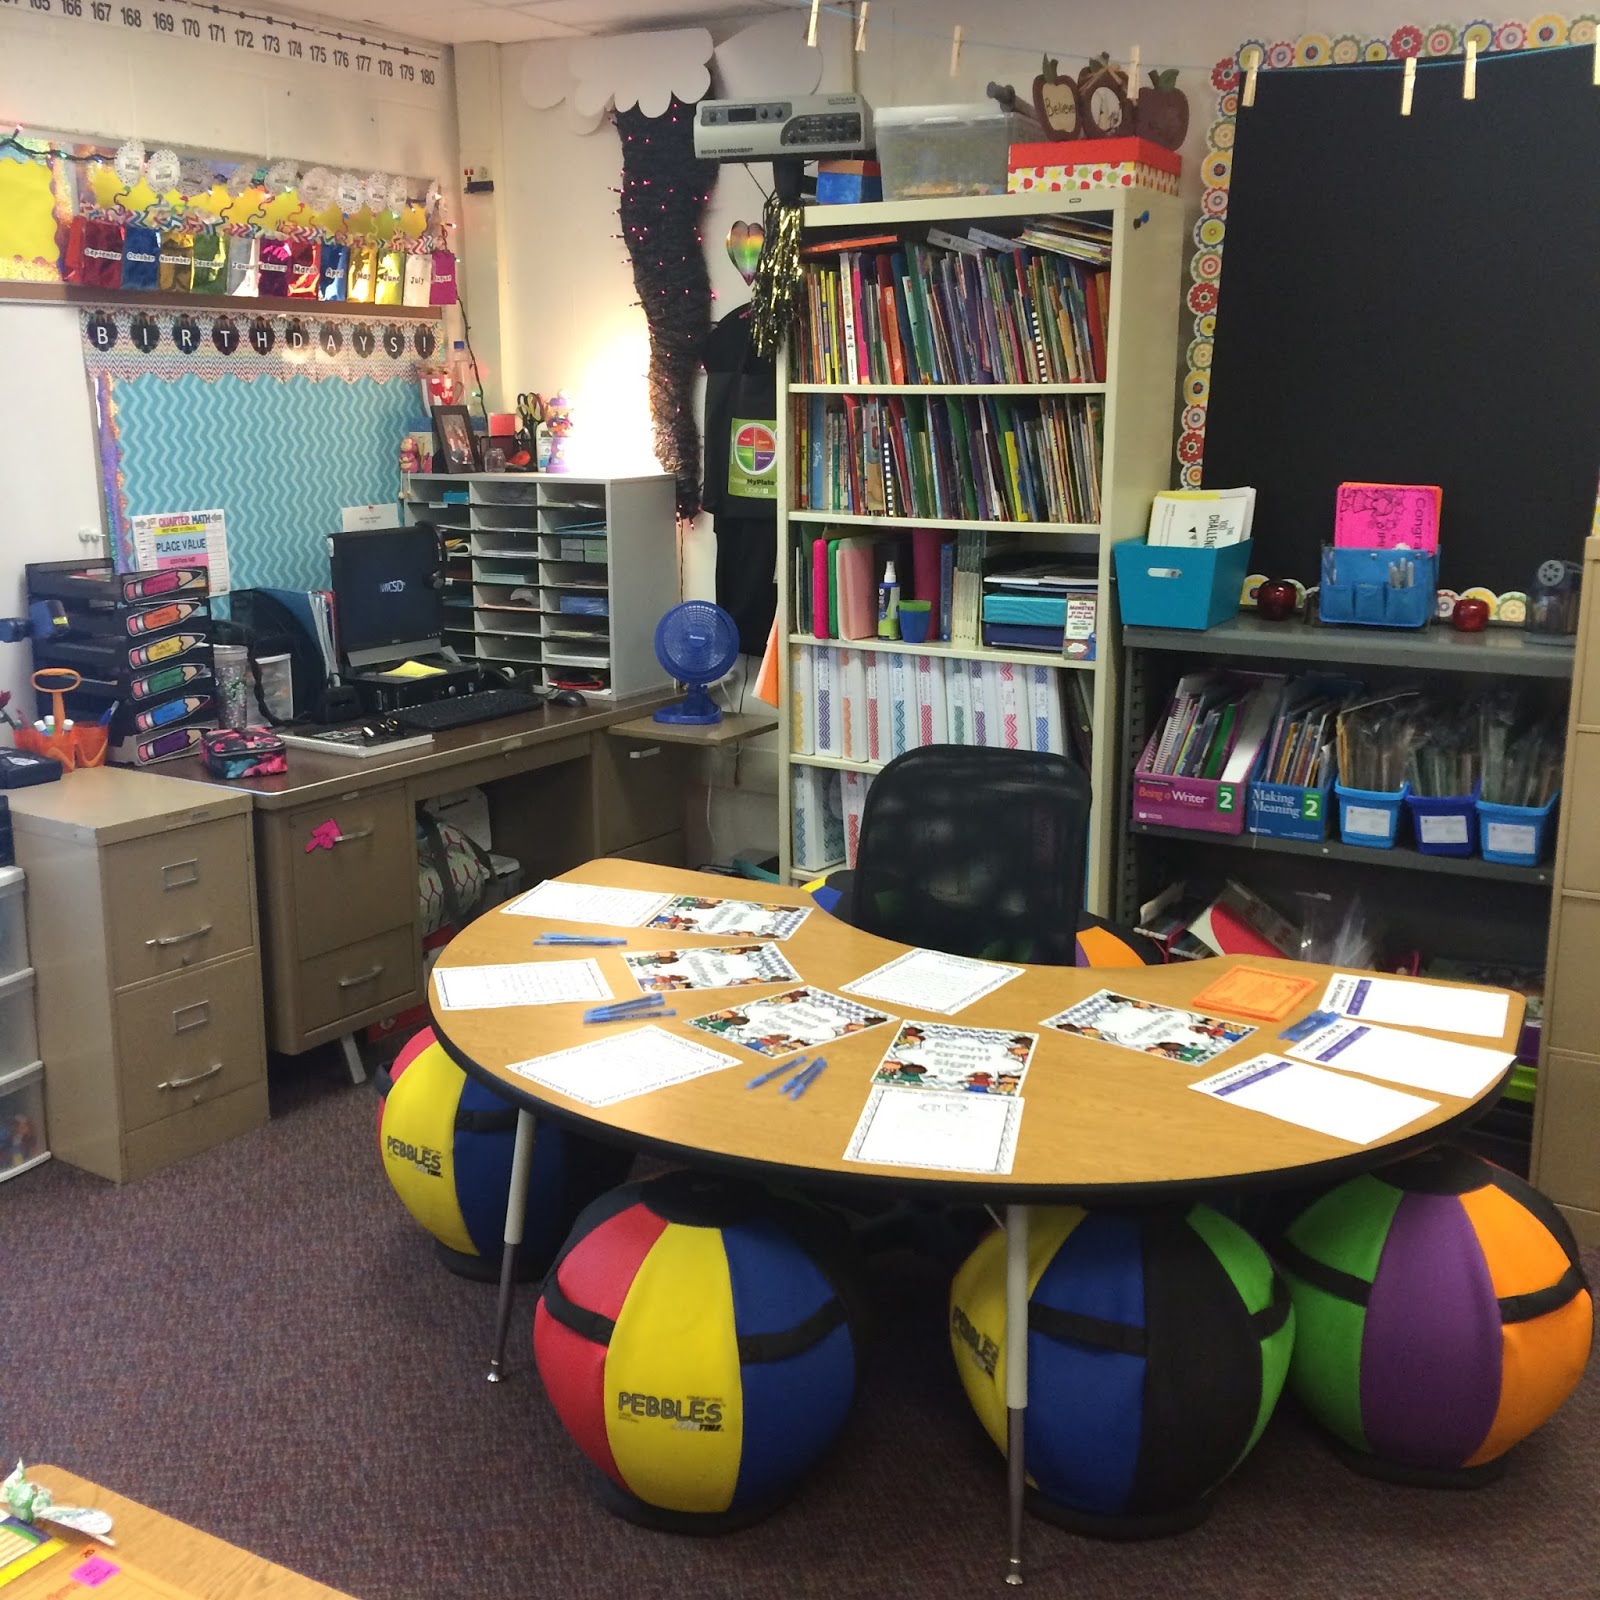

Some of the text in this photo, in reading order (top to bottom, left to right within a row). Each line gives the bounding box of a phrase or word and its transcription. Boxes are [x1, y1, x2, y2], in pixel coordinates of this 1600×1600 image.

[61, 0, 82, 16] 166
[91, 3, 111, 22] 167
[121, 7, 142, 28] 168
[153, 12, 174, 32] 169
[181, 18, 200, 37] 170
[208, 24, 226, 43] 171
[234, 28, 254, 49] 172
[262, 34, 280, 53] 173
[288, 40, 302, 58] 174
[309, 45, 327, 63] 175
[333, 49, 349, 68] 176
[356, 54, 371, 72] 177
[378, 59, 393, 77] 178
[400, 63, 414, 81] 179
[420, 68, 435, 86] 180
[85, 249, 122, 260] September
[127, 253, 155, 262] October
[159, 255, 191, 264] November
[194, 259, 224, 267] December
[294, 265, 318, 274] March
[326, 268, 344, 279] April
[357, 272, 371, 280] May
[383, 273, 400, 281] June
[410, 276, 424, 285] July
[158, 515, 190, 528] QUARTER
[191, 514, 211, 525] MATH
[156, 538, 206, 552] PLACE VALUE
[1138, 787, 1208, 804] Being a Writer
[1219, 791, 1232, 809] 2
[1252, 788, 1295, 807] Making
[1252, 800, 1301, 819] Meaning
[1305, 800, 1318, 817] 2
[934, 1041, 989, 1053] Room
[924, 1049, 992, 1061] Parent
[933, 1059, 976, 1069] Sign
[387, 1134, 442, 1171] PEBBLES
[617, 1391, 723, 1423] PEBBLES
